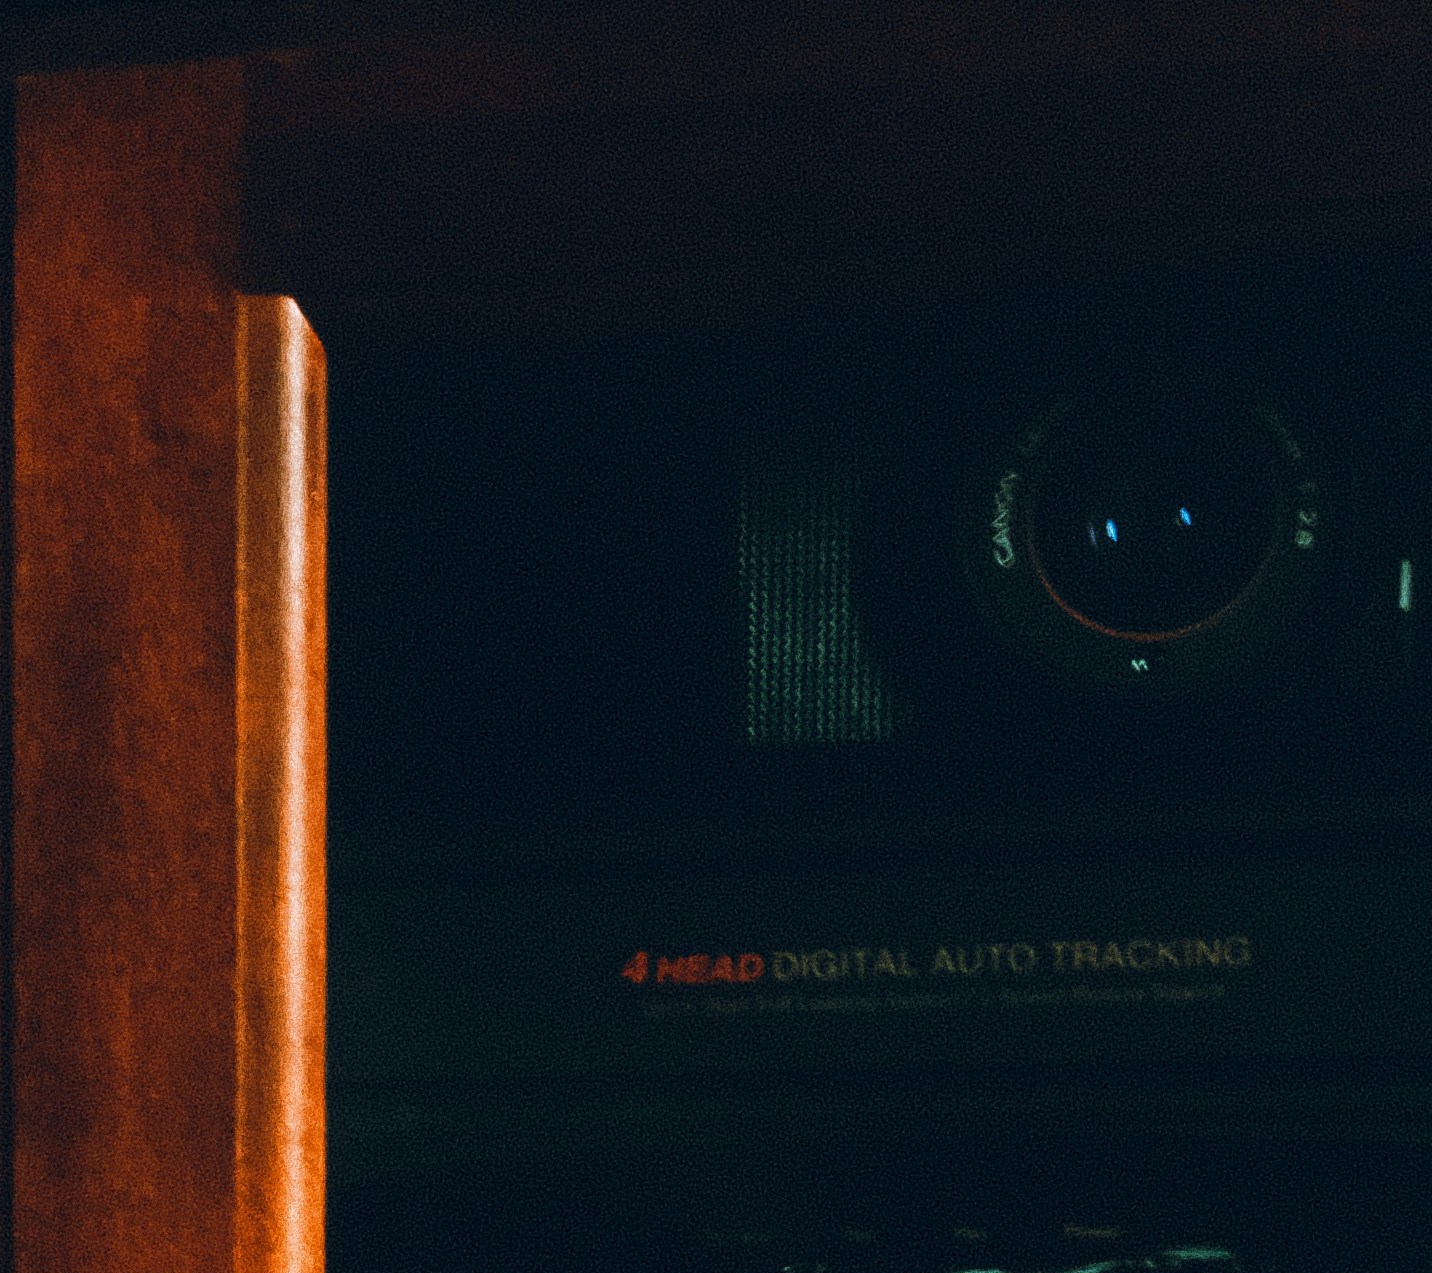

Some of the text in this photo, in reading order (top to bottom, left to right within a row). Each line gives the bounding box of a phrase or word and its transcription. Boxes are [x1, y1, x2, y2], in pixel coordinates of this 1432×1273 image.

[620, 936, 1254, 985] 4 HEAD DIGITAL AUTO TRACKING
